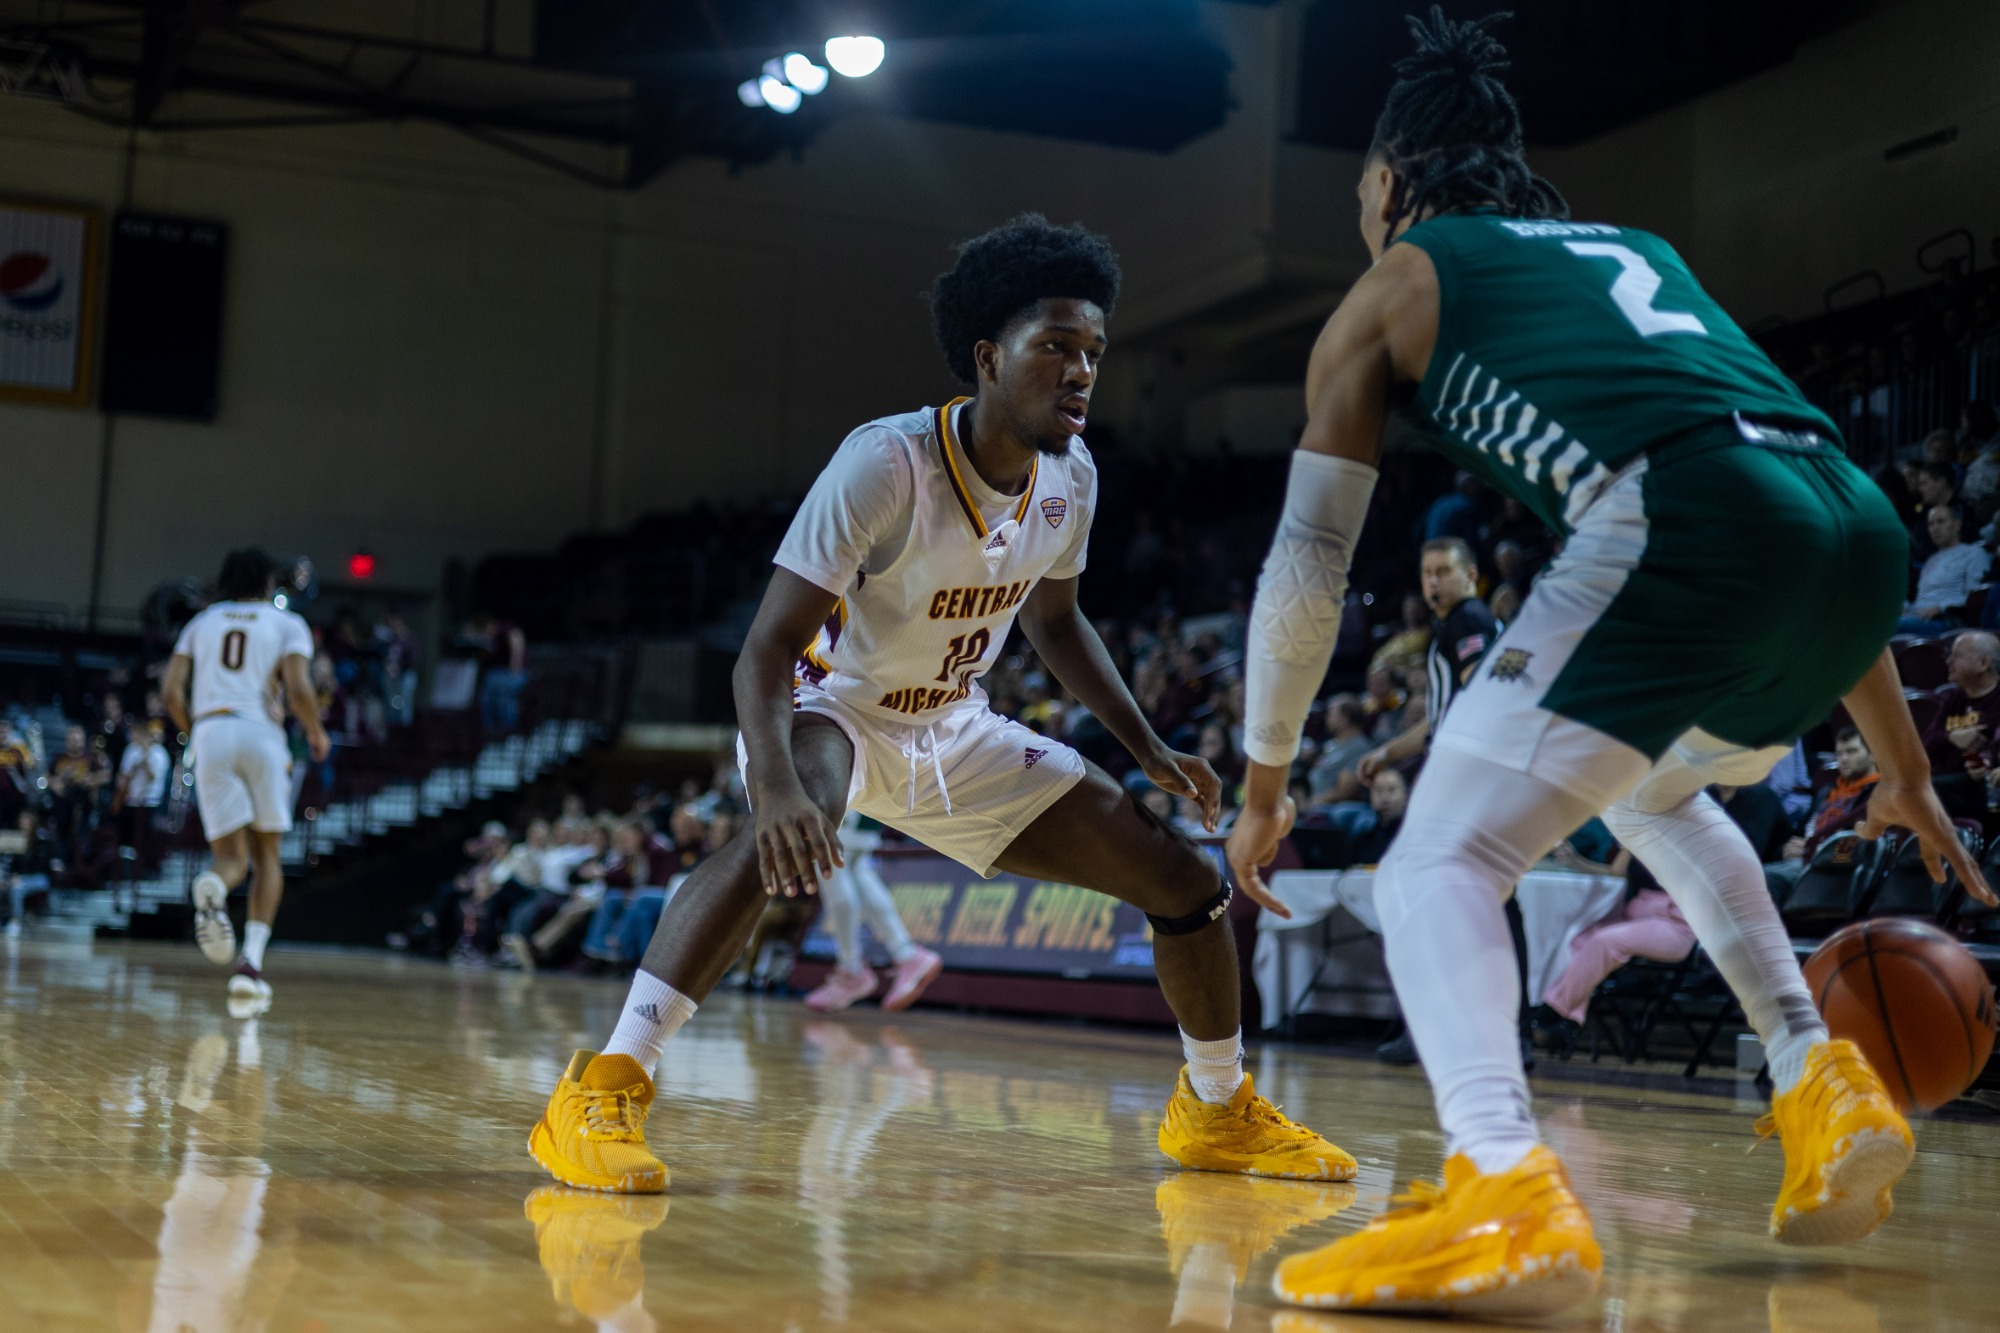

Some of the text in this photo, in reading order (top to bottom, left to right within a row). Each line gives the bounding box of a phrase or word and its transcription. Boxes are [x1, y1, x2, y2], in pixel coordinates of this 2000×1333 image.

[1562, 241, 1709, 338] 2
[1044, 506, 1066, 516] MAC
[928, 578, 1031, 620] CENTRAL
[222, 629, 247, 671] 0
[1025, 749, 1049, 769] adidas
[633, 1007, 662, 1025] adidas
